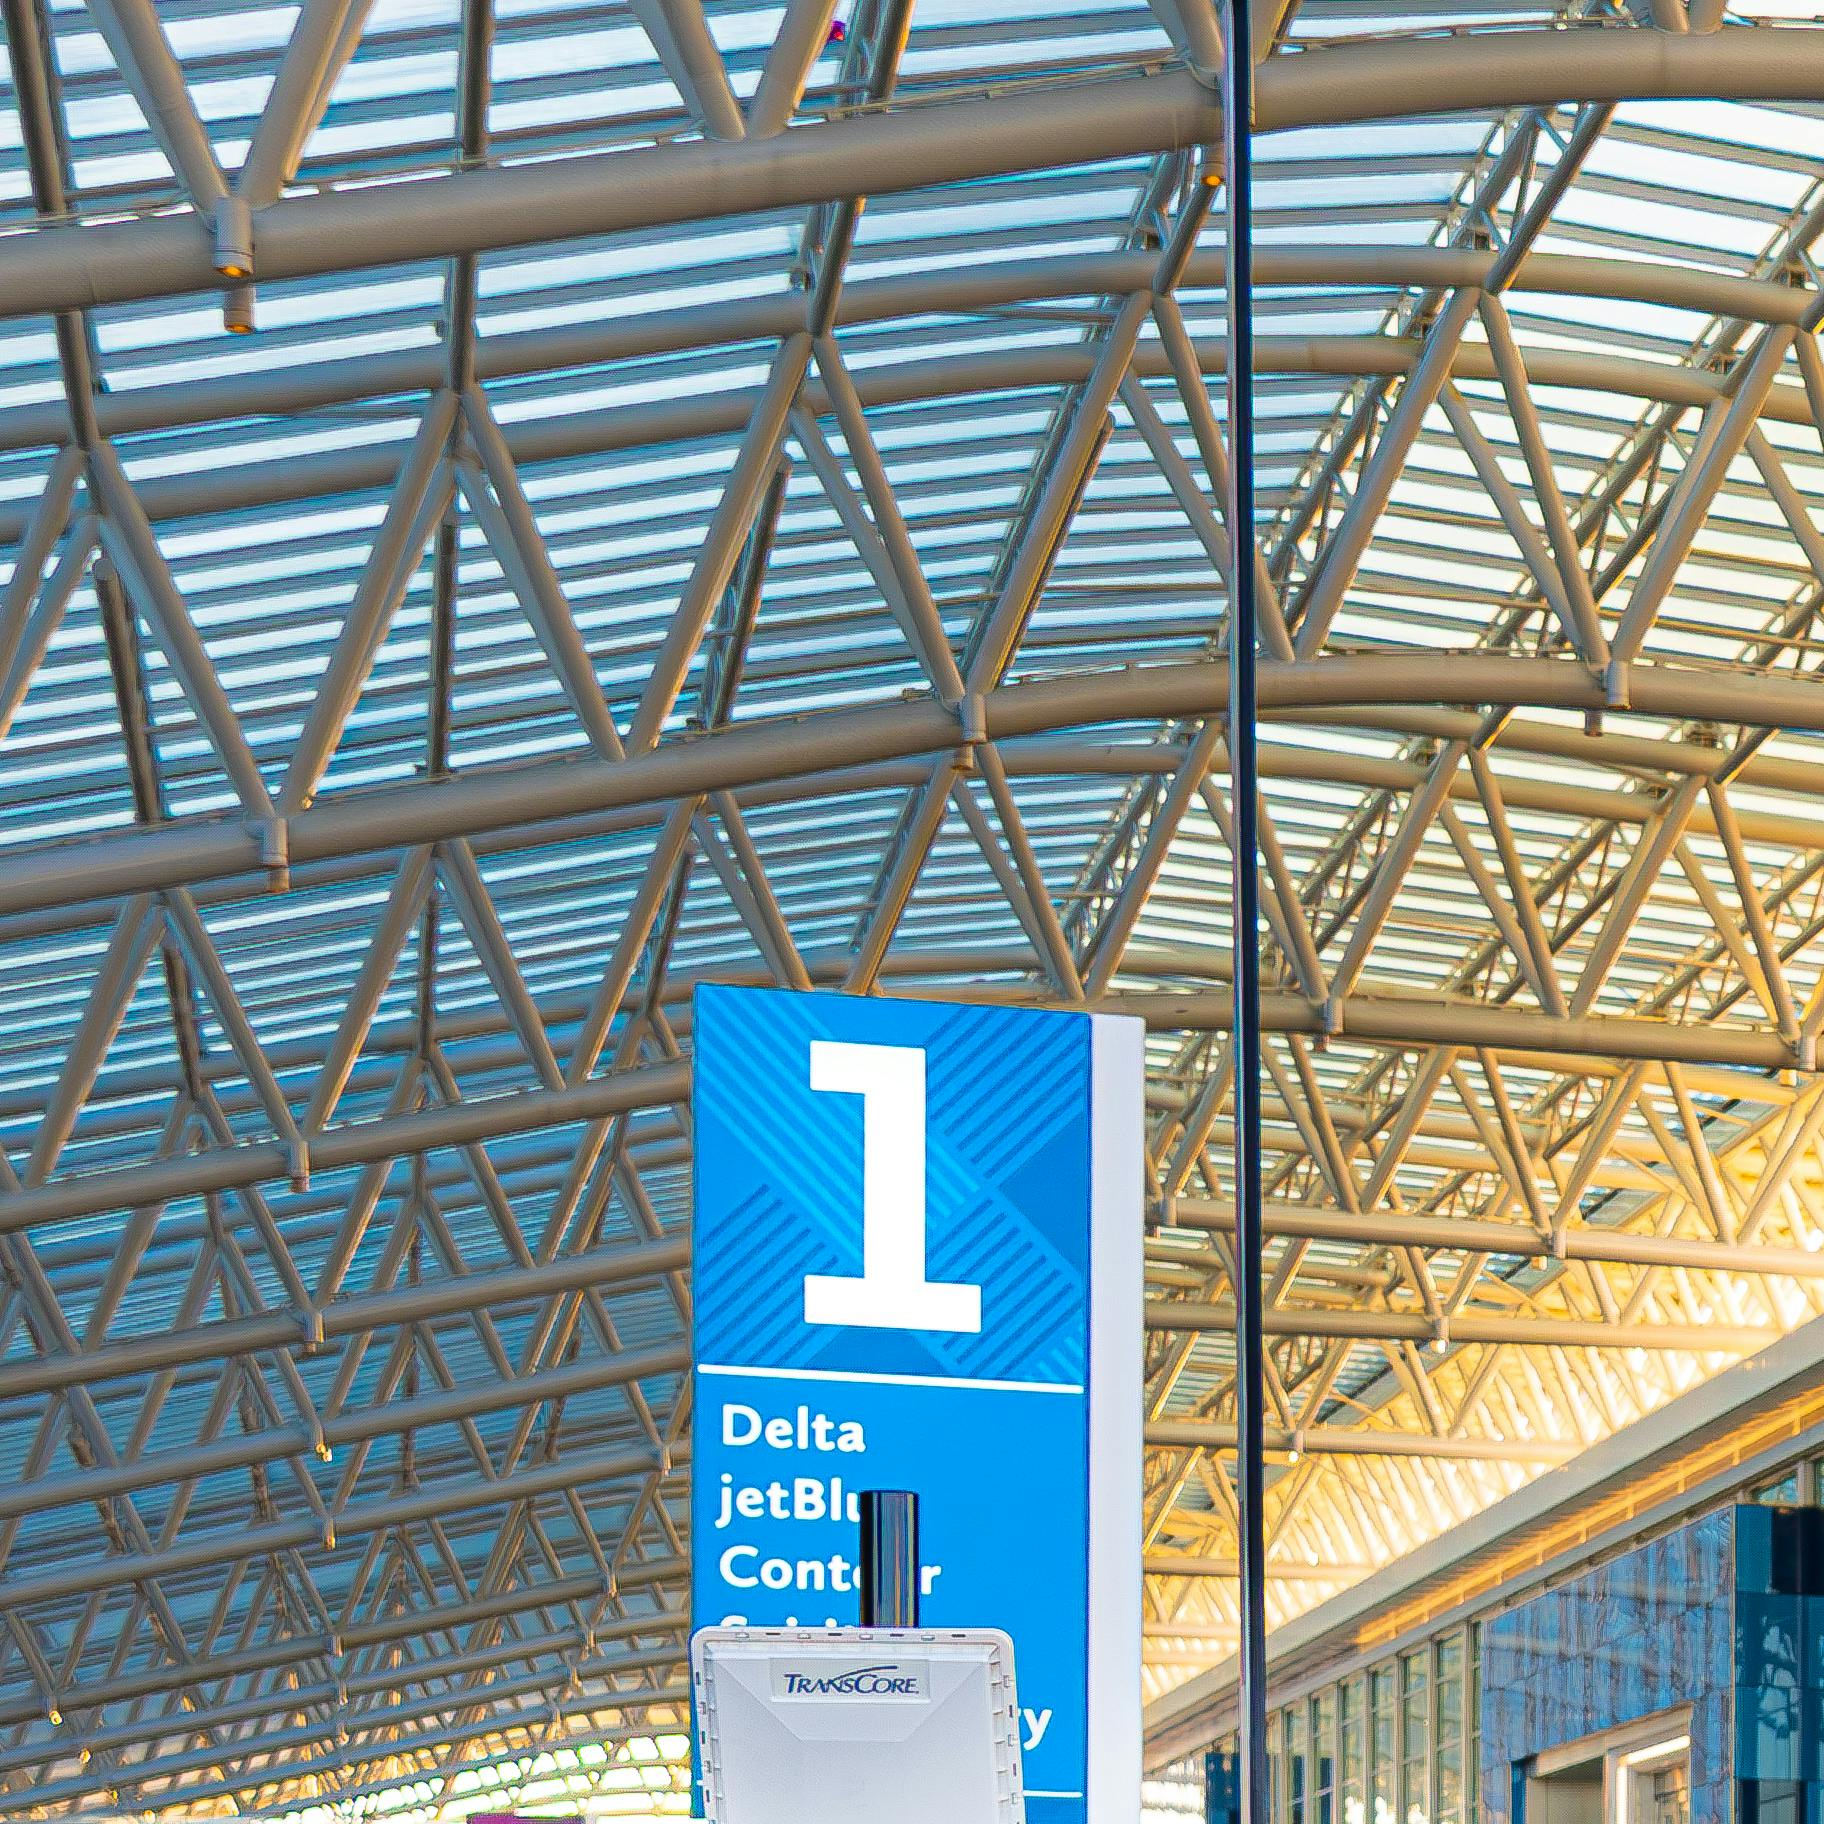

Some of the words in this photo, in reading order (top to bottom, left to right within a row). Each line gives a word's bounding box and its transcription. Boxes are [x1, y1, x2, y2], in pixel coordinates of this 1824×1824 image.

[804, 1040, 982, 1333] 1
[722, 1403, 866, 1454] Delta
[719, 1545, 942, 1595] Contr
